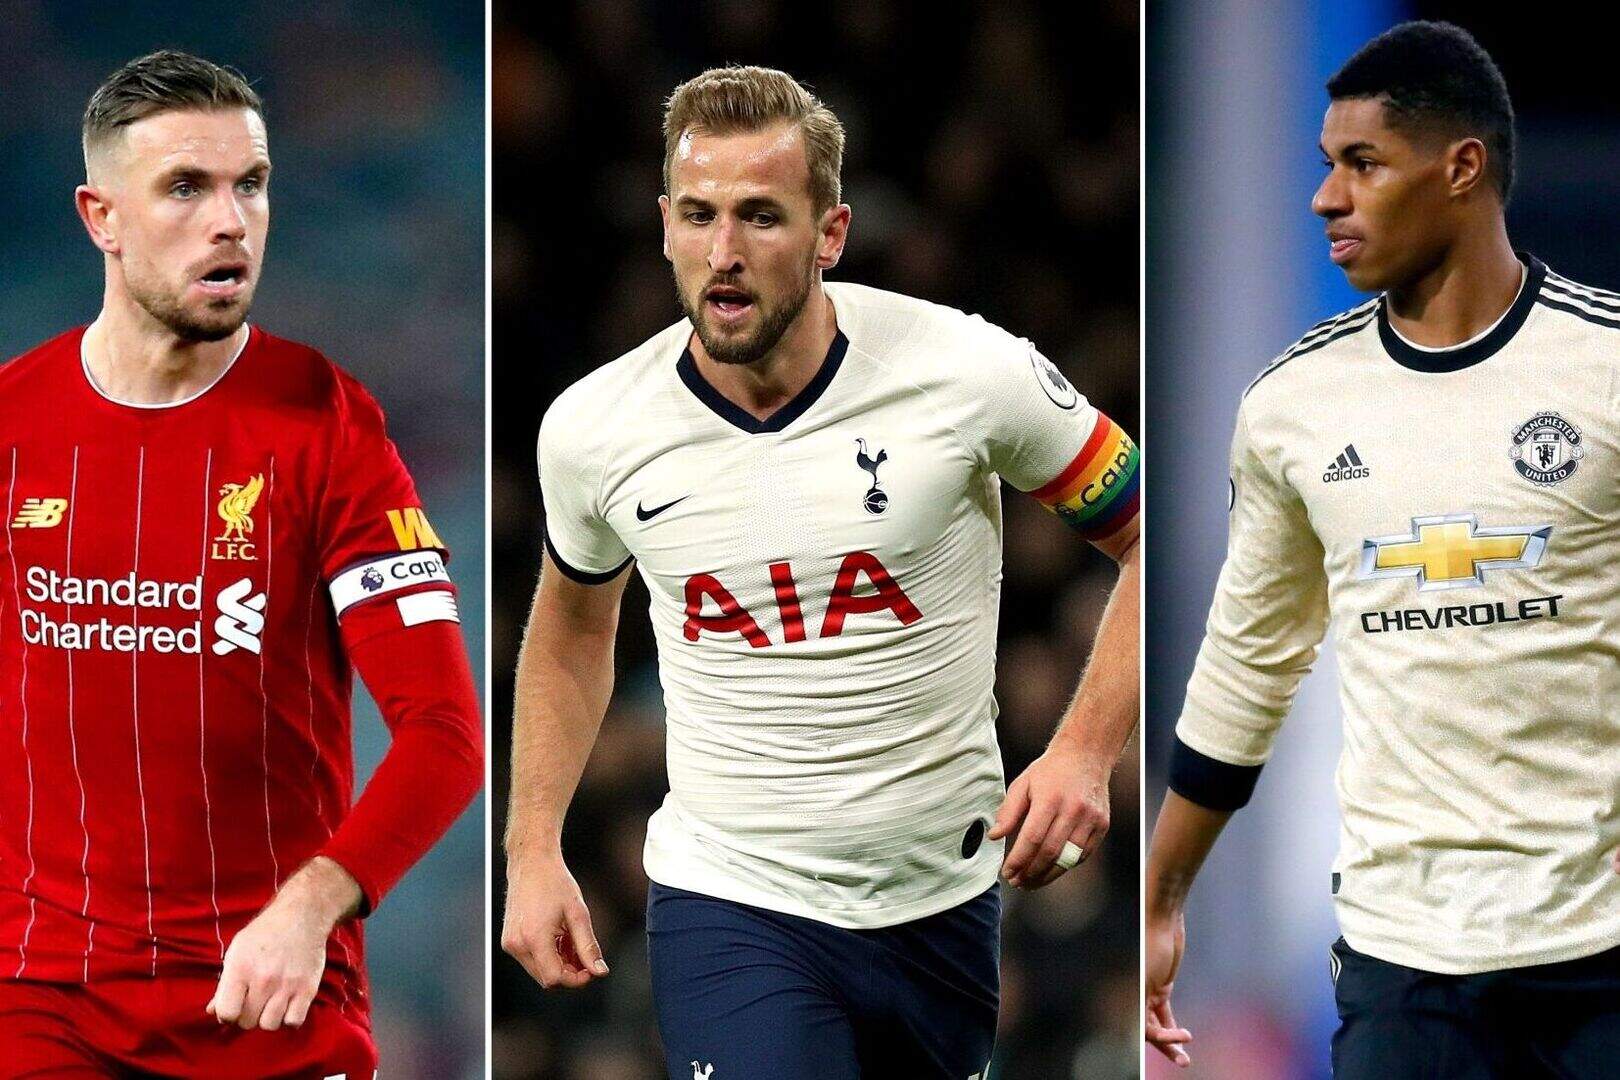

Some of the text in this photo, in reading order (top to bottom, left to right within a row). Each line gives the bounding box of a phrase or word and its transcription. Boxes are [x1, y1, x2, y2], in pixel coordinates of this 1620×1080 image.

[1517, 417, 1577, 442] MANCHESTER
[1322, 467, 1370, 483] adidas
[1525, 469, 1567, 482] UNITED
[26, 566, 203, 611] Standard
[683, 552, 924, 648] AIA
[21, 609, 202, 654] Chartered
[1361, 595, 1563, 633] CHEVROLET
